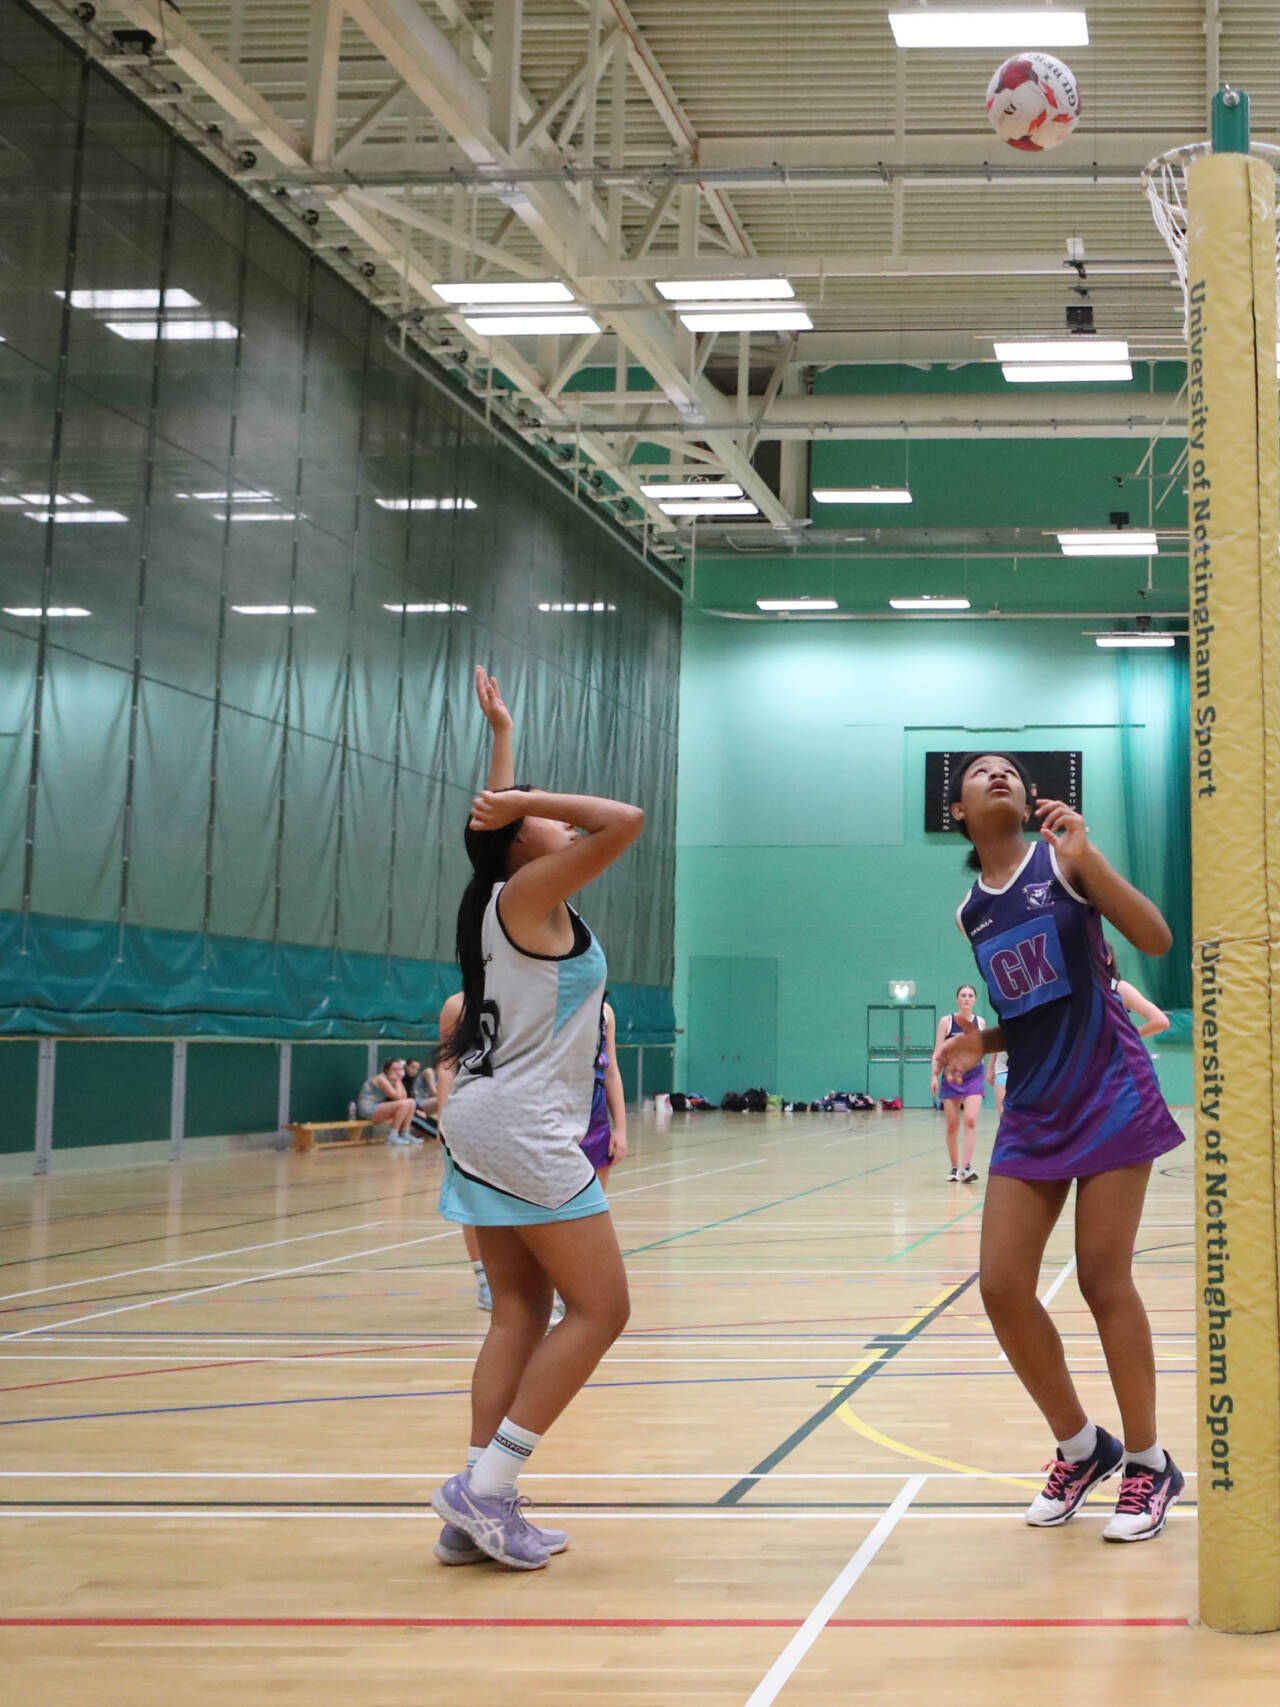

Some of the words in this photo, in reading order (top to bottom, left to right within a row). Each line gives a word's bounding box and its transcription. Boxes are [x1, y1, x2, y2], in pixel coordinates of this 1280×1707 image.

[1190, 280, 1208, 450] University
[1193, 459, 1211, 491] of
[1193, 498, 1214, 700] Nottingham
[1195, 706, 1217, 799] Sport
[990, 933, 1058, 1000] GK
[1201, 940, 1224, 1121] University
[1205, 1130, 1228, 1164] of
[1204, 1173, 1231, 1386] Nottingham
[1206, 1394, 1234, 1491] Sport
